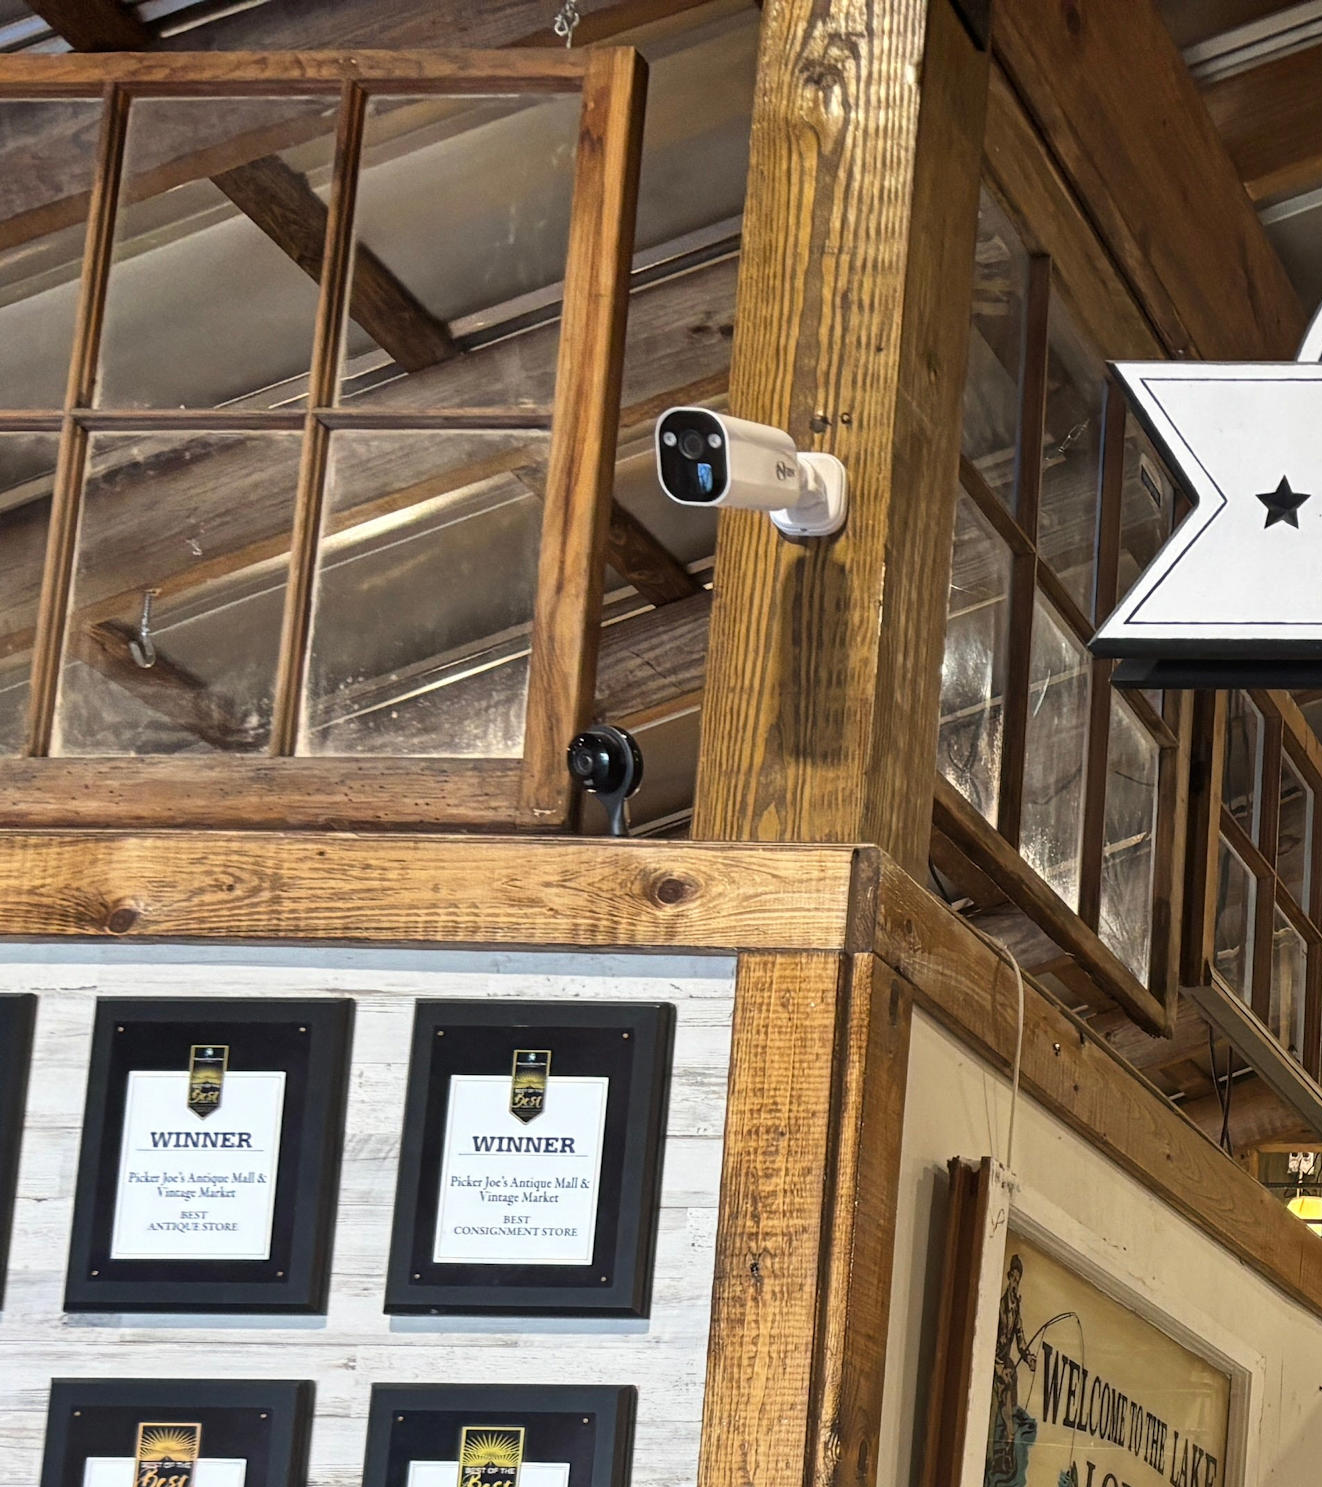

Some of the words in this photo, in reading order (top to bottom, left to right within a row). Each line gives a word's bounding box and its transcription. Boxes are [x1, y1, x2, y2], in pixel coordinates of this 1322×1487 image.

[150, 1132, 253, 1148] WINNER
[472, 1136, 576, 1153] WINNER
[128, 1172, 160, 1183] Picker
[161, 1172, 186, 1186] Joe's
[187, 1172, 229, 1187] Antique
[231, 1172, 255, 1184] Mall
[257, 1174, 267, 1184] &
[450, 1176, 482, 1187] Picker
[484, 1176, 508, 1190] Joe's
[511, 1177, 552, 1193] Antique
[554, 1177, 578, 1189] Mall
[580, 1180, 590, 1189] &
[157, 1187, 196, 1201] Vintage
[198, 1186, 236, 1198] Market
[479, 1191, 519, 1205] Vintage
[521, 1191, 559, 1203] Market
[180, 1211, 208, 1219] BEST
[503, 1216, 530, 1224] BEST
[148, 1222, 199, 1233] ANTIQUE
[202, 1222, 238, 1231] STORE
[454, 1227, 540, 1236] CONSIGNMENT
[542, 1227, 578, 1236] STORE
[1042, 1341, 1128, 1448] WELCOME
[1129, 1401, 1144, 1457] TO
[1143, 1411, 1168, 1475] THE
